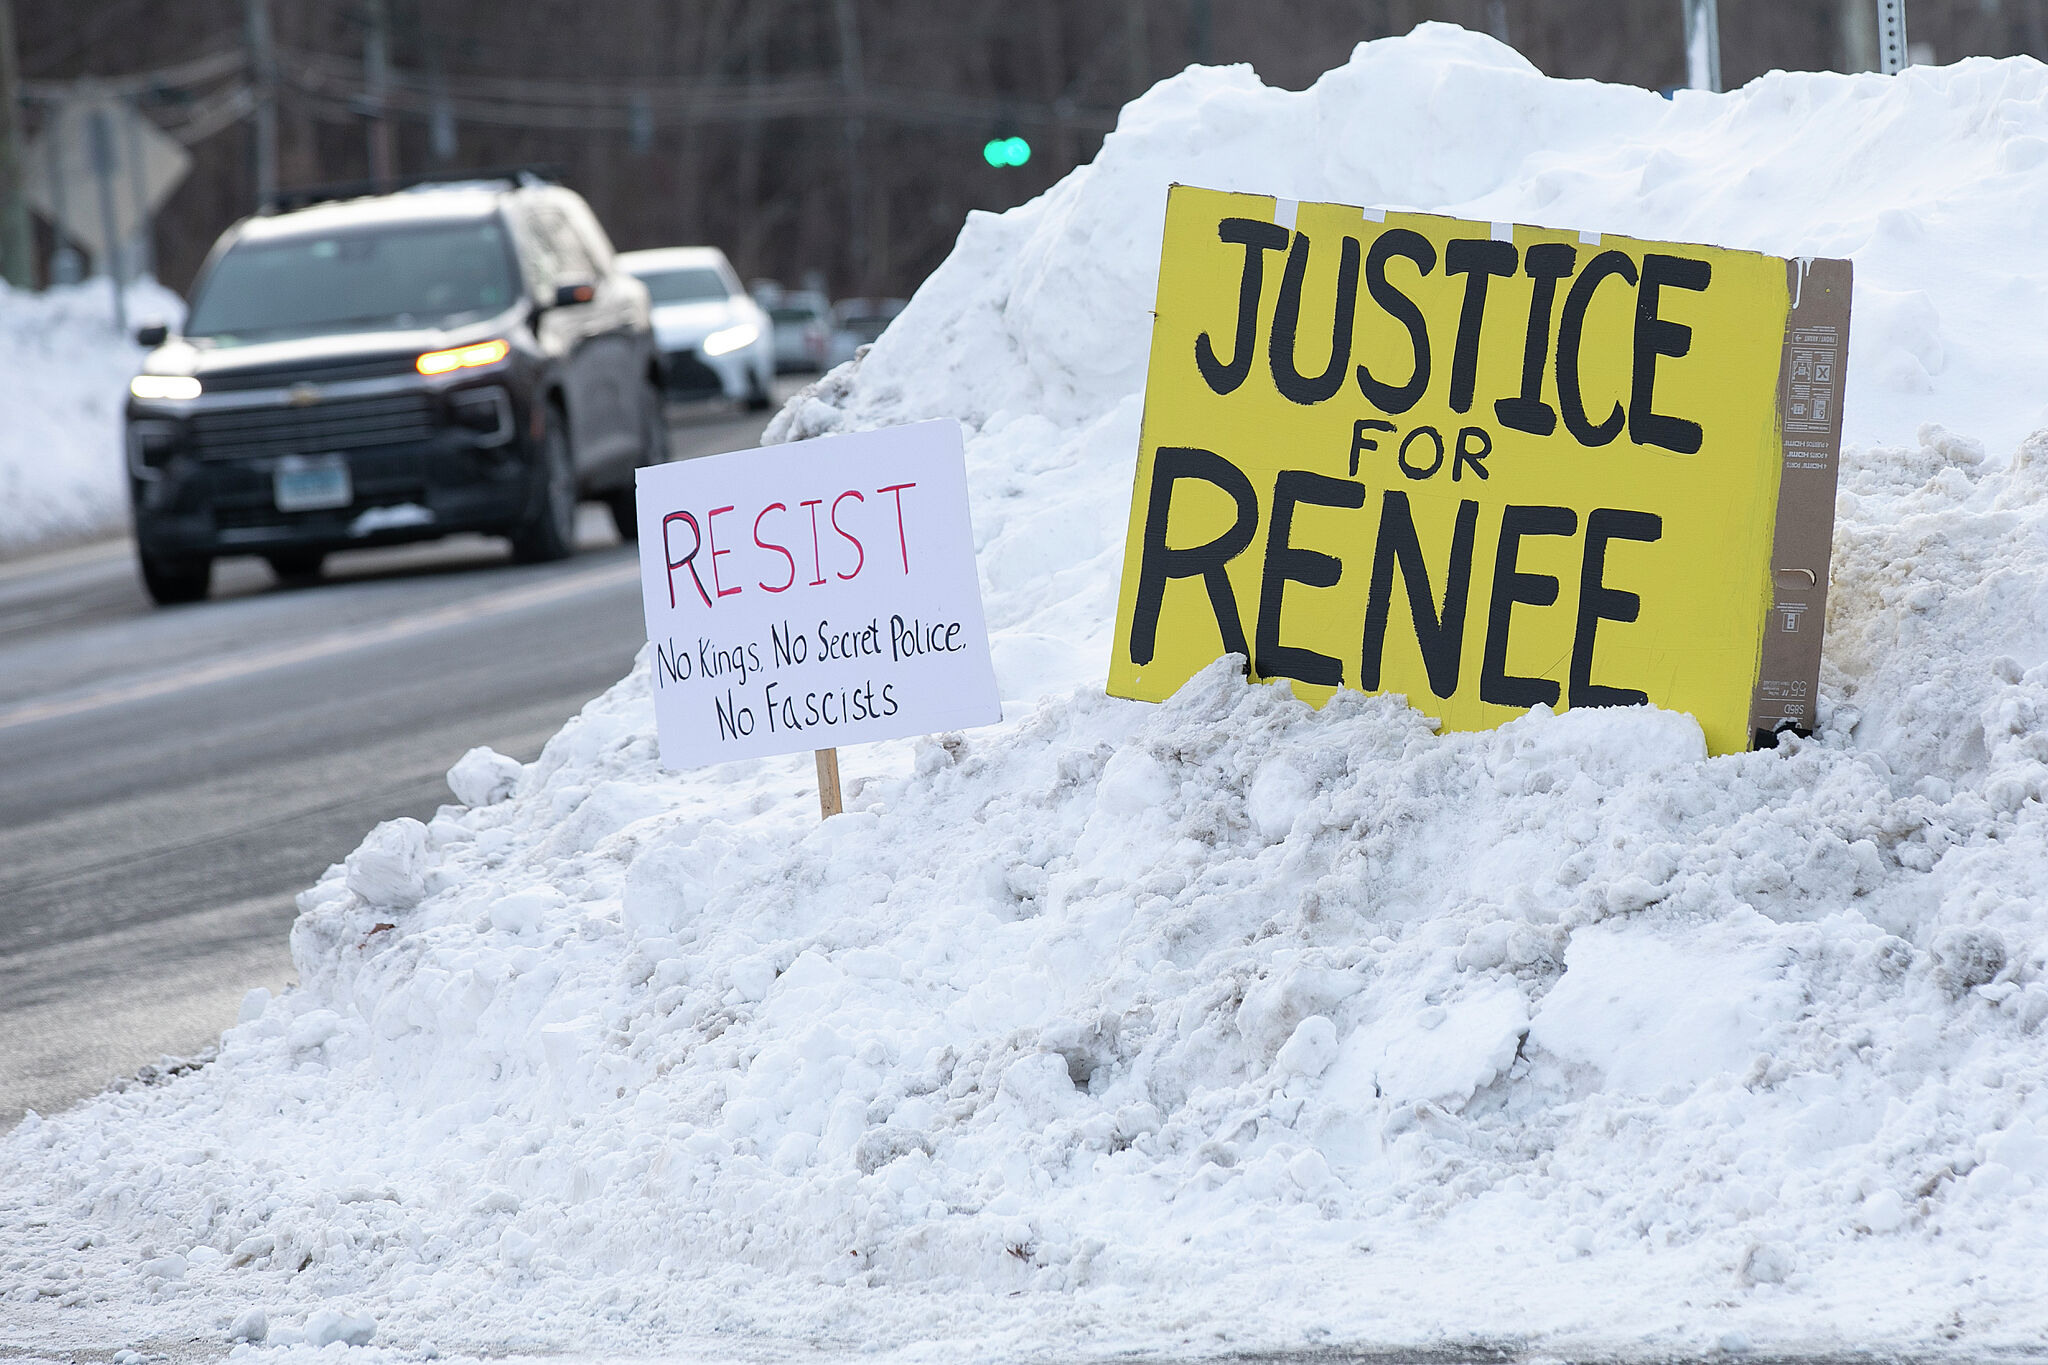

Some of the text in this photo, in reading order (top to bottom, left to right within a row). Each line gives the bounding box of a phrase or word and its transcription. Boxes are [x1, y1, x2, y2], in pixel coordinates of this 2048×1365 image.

[1195, 217, 1712, 455] JUSTICE
[1349, 418, 1493, 483] FOR
[662, 482, 917, 610] RESIST
[1130, 446, 1663, 711] RENEE
[657, 637, 692, 689] No
[771, 619, 807, 669] No
[818, 617, 882, 662] Secret
[715, 680, 898, 741] No Fascists
